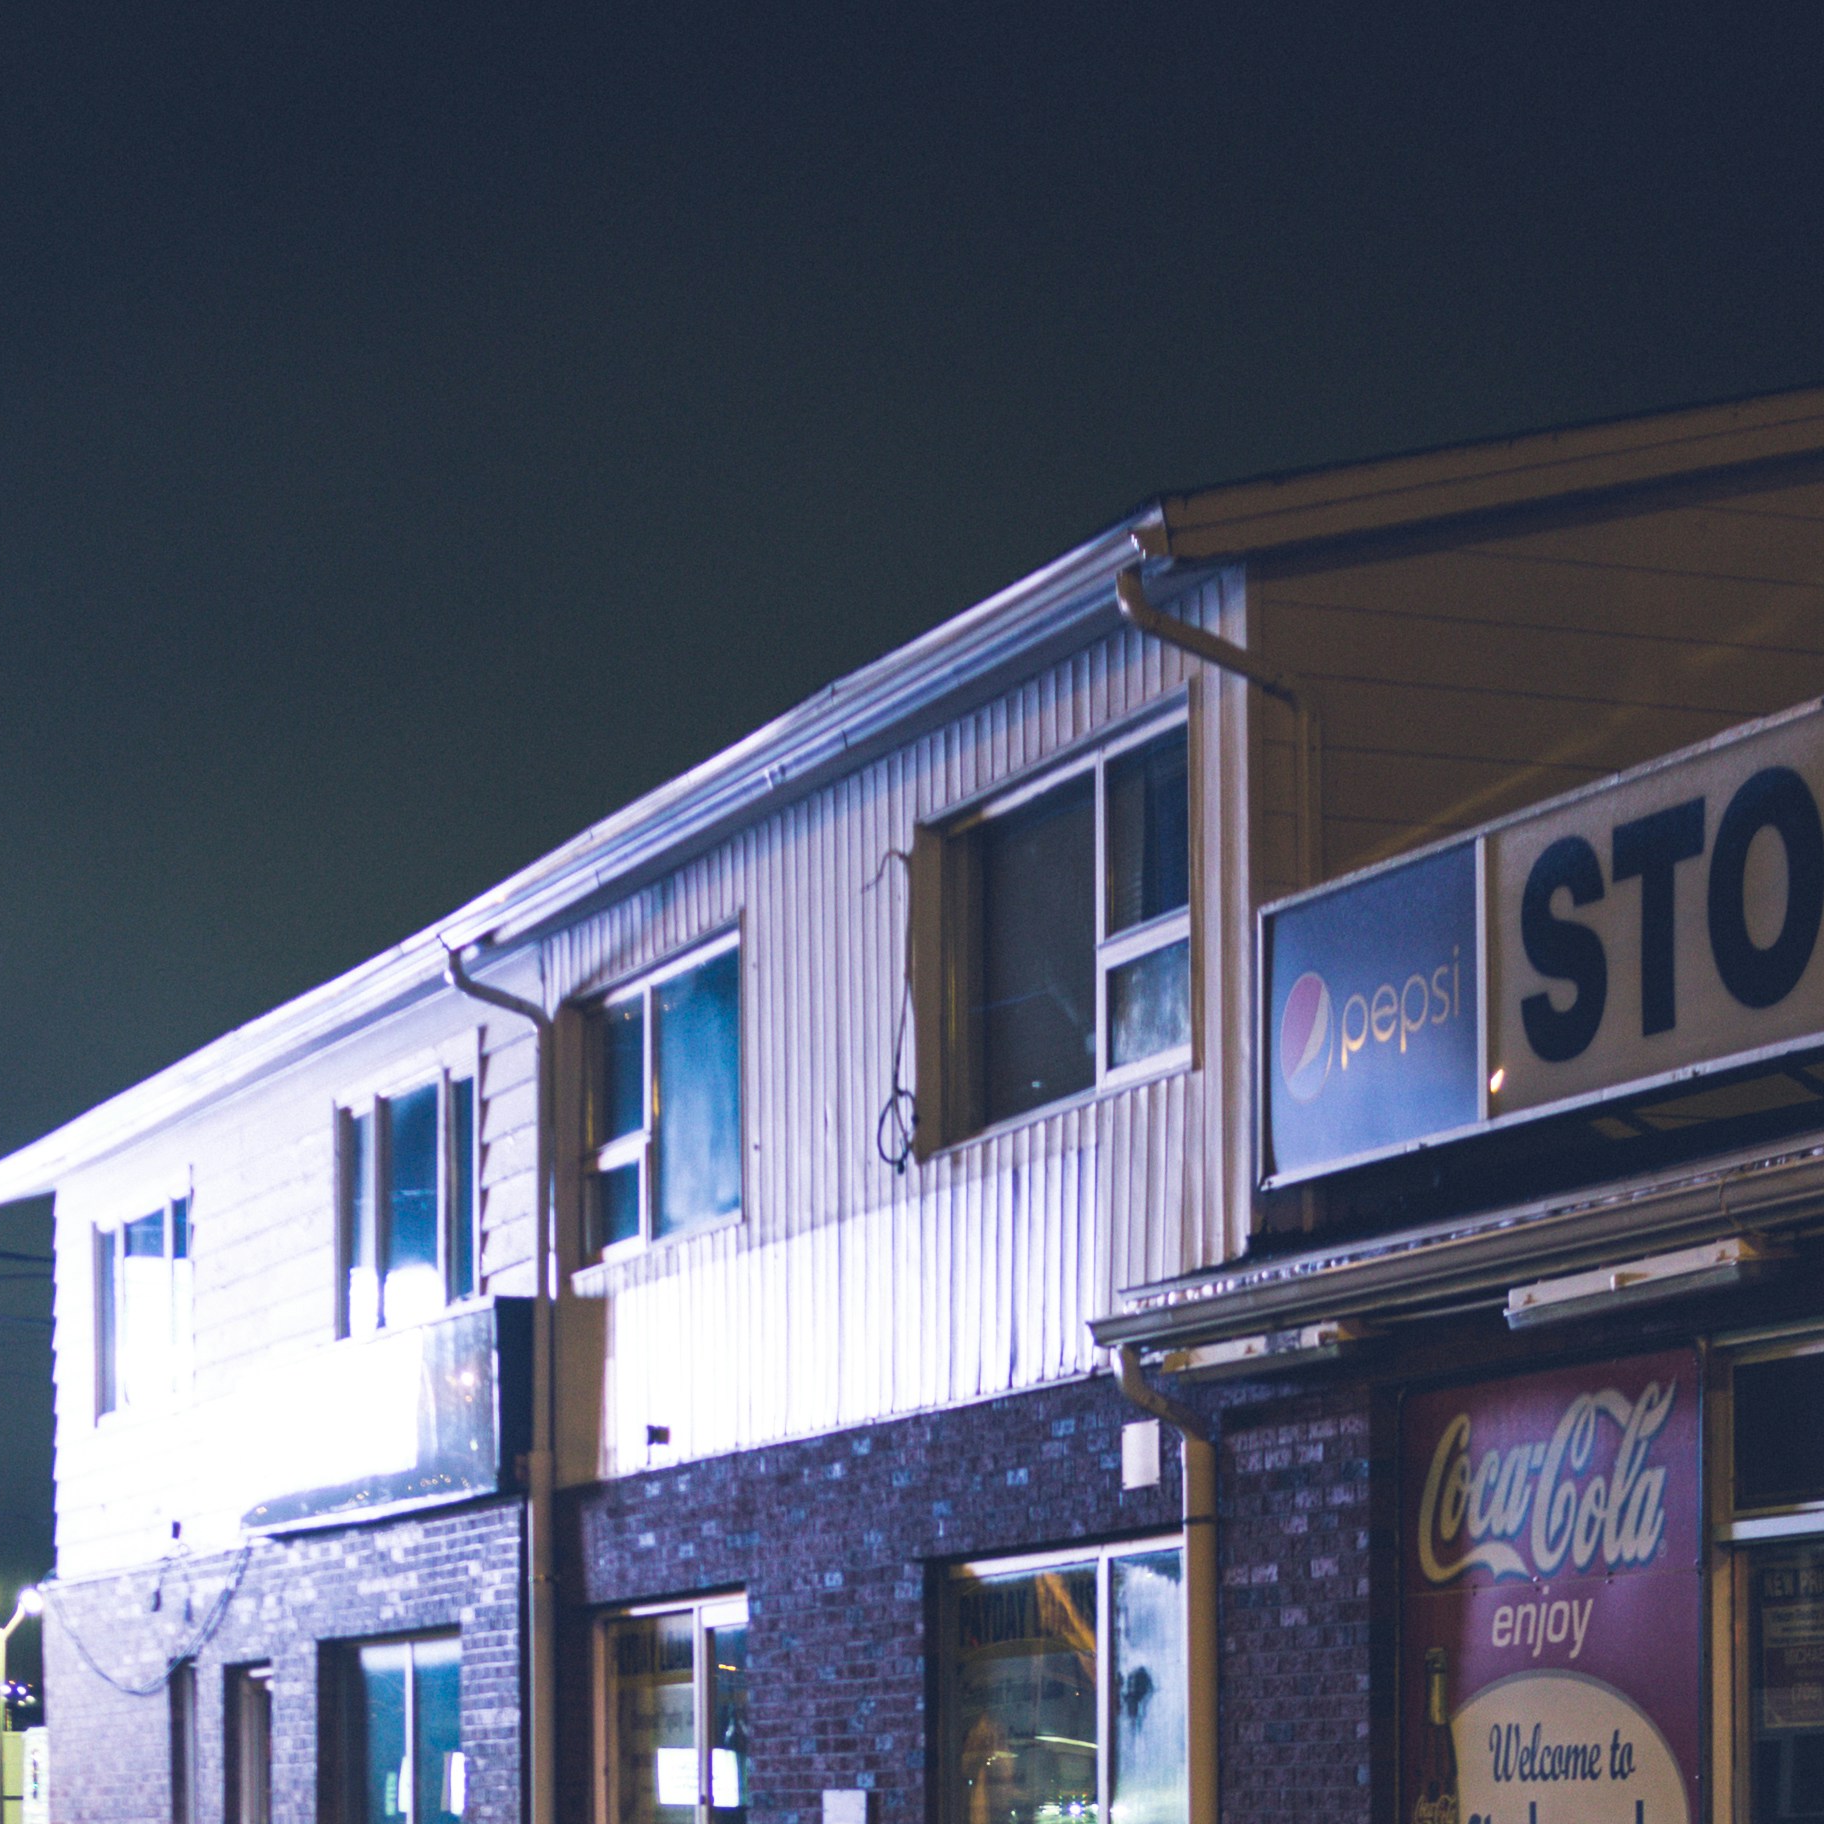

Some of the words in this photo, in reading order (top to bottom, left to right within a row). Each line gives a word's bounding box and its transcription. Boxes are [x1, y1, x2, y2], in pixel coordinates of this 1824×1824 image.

[1341, 944, 1461, 1071] pepsi
[1418, 1376, 1676, 1583] Coca-Cola
[1492, 1585, 1594, 1659] enjoy
[1489, 1722, 1603, 1783] Welcome
[1609, 1728, 1636, 1781] to
